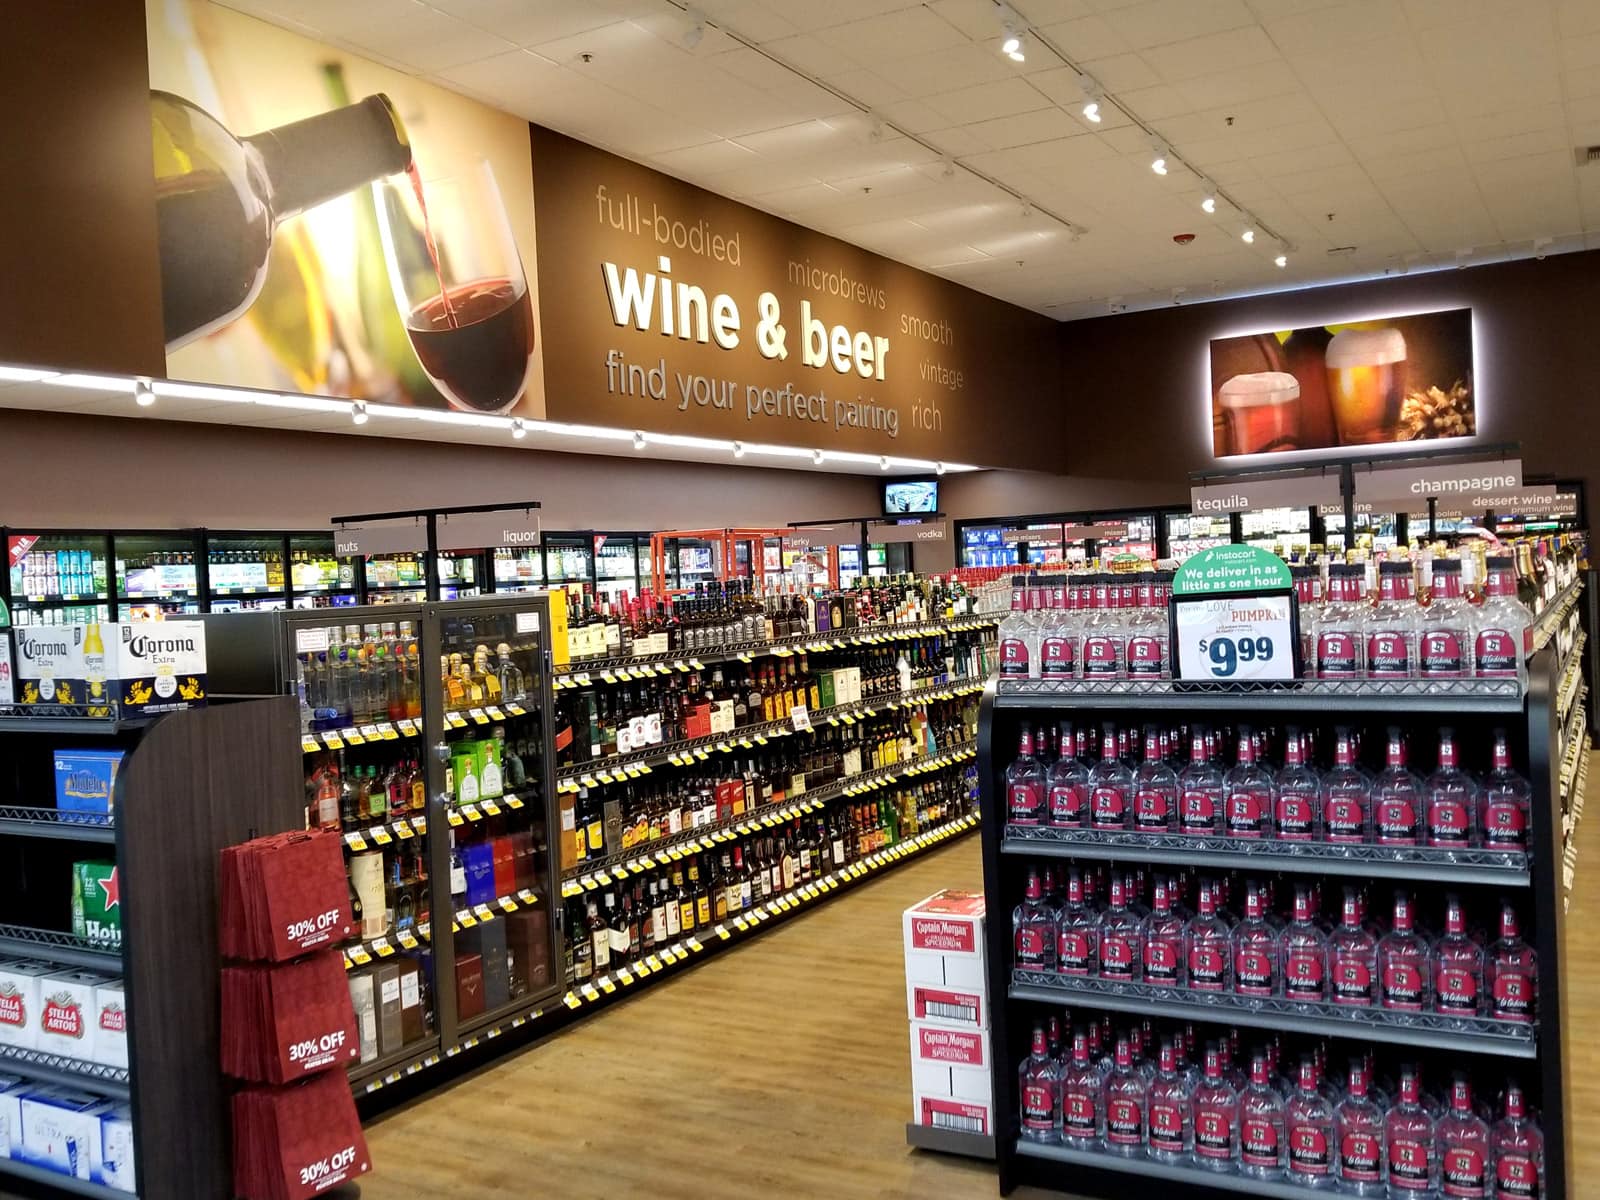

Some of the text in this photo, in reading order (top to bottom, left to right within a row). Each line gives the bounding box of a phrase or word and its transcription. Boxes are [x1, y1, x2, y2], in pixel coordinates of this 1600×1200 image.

[596, 184, 741, 266] full-bodied
[788, 258, 886, 310] microbrews
[601, 255, 890, 381] wine & beer
[900, 311, 954, 346] smooth
[919, 360, 964, 390] vintage
[605, 349, 899, 438] find your perfect pairing
[911, 400, 943, 432] rich
[1410, 475, 1516, 493] champagne
[1196, 494, 1249, 512] tequila
[1320, 502, 1373, 514] box ine
[1472, 494, 1552, 507] dessert wine
[1436, 509, 1463, 518] oolers
[1511, 503, 1574, 515] premium wine
[503, 529, 536, 544] liquor
[791, 537, 810, 547] jerky
[917, 529, 943, 539] vodka
[337, 541, 359, 553] nuts
[1216, 550, 1257, 560] Instacart
[1185, 563, 1278, 579] We deliver in as
[1182, 576, 1283, 592] little as one hour
[24, 638, 67, 661] Corona
[129, 635, 195, 660] Corona
[152, 654, 175, 664] Extra
[85, 877, 93, 887] 12
[287, 917, 316, 940] 30%
[317, 908, 340, 929] OFF
[917, 921, 967, 936] Captain Morgan
[0, 998, 19, 1010] ELLA
[48, 1007, 77, 1021] STELLA
[103, 1012, 123, 1022] STELLA
[47, 1018, 77, 1032] ARTOIS
[289, 1038, 318, 1061] 30%
[320, 1030, 345, 1051] OFF
[924, 1031, 975, 1048] Captain Morgan
[300, 1158, 330, 1184] 30%
[331, 1146, 356, 1169] OFF
